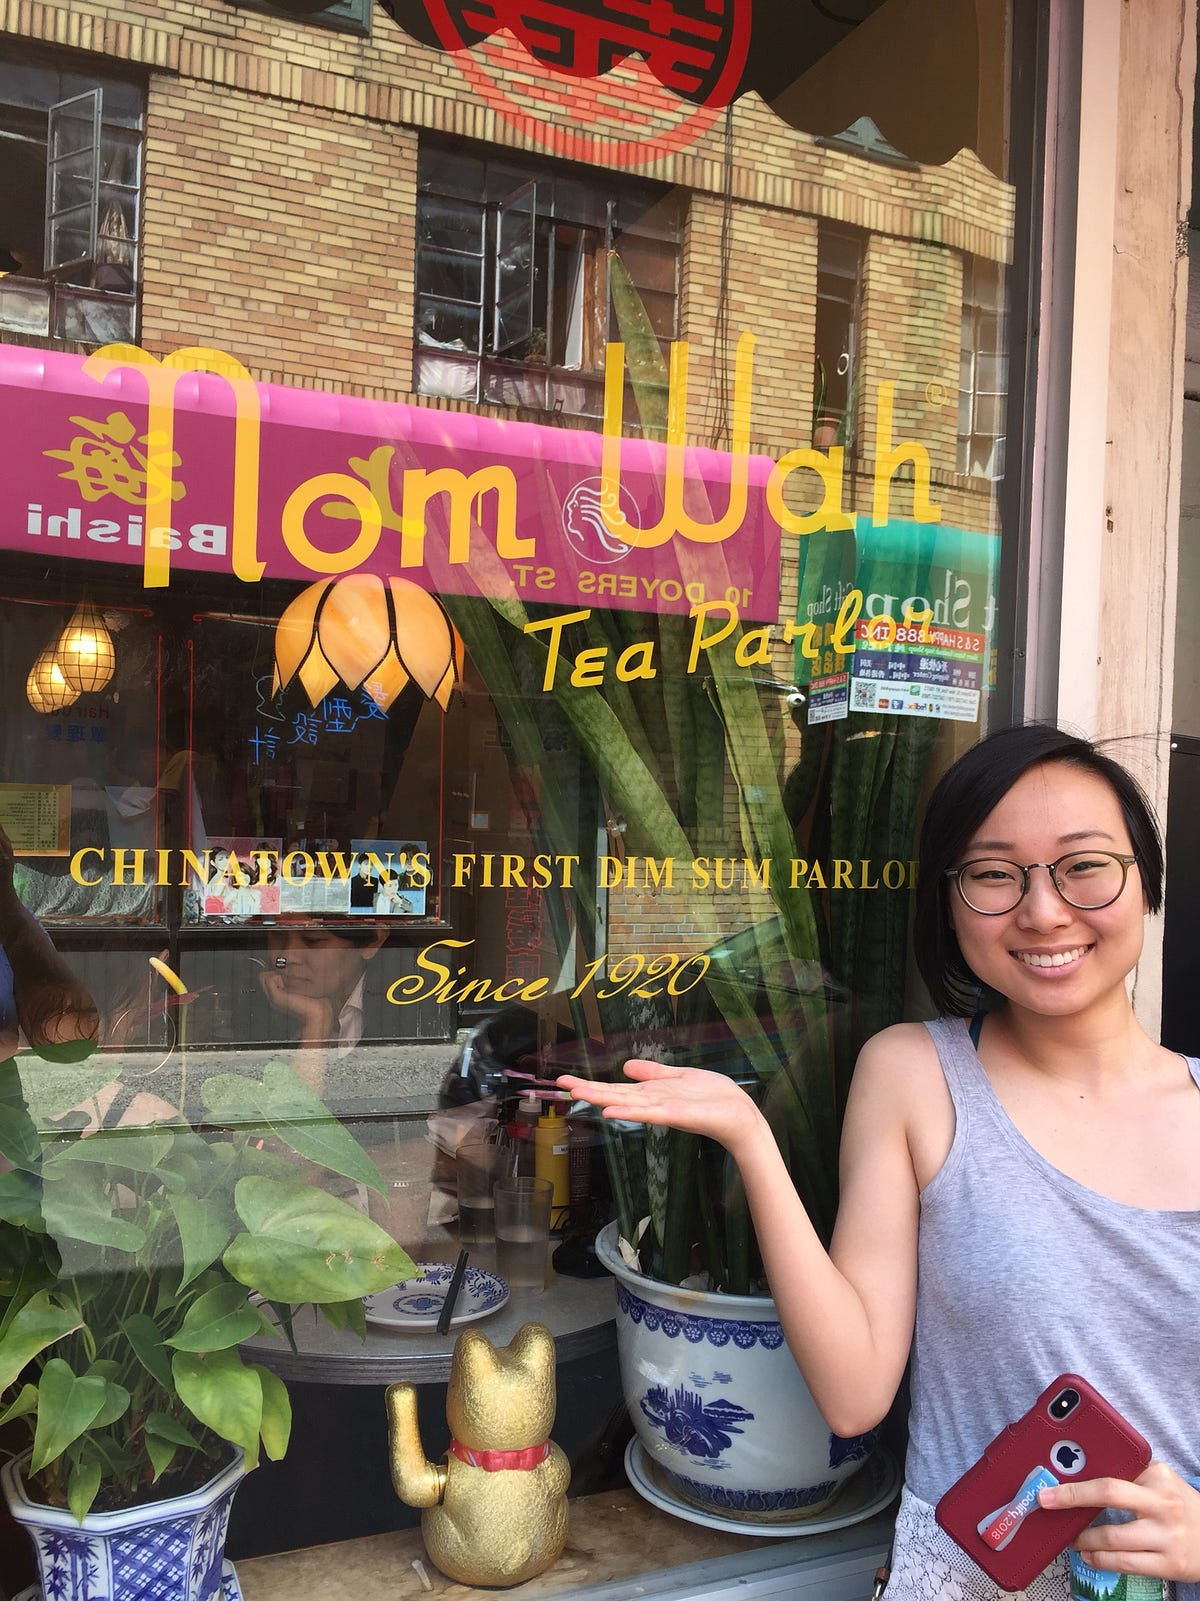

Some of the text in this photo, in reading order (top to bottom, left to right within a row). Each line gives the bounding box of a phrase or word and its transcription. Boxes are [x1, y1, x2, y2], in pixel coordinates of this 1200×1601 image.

[81, 343, 536, 588] Nom
[604, 328, 942, 548] Wah
[523, 609, 657, 693] Tea
[686, 589, 935, 676] Parlor
[69, 846, 432, 890] CHINATOWN'S
[452, 853, 581, 890] FIRST
[598, 854, 675, 889] DIM
[691, 856, 773, 890] SUM
[386, 939, 711, 1006] Since 1920
